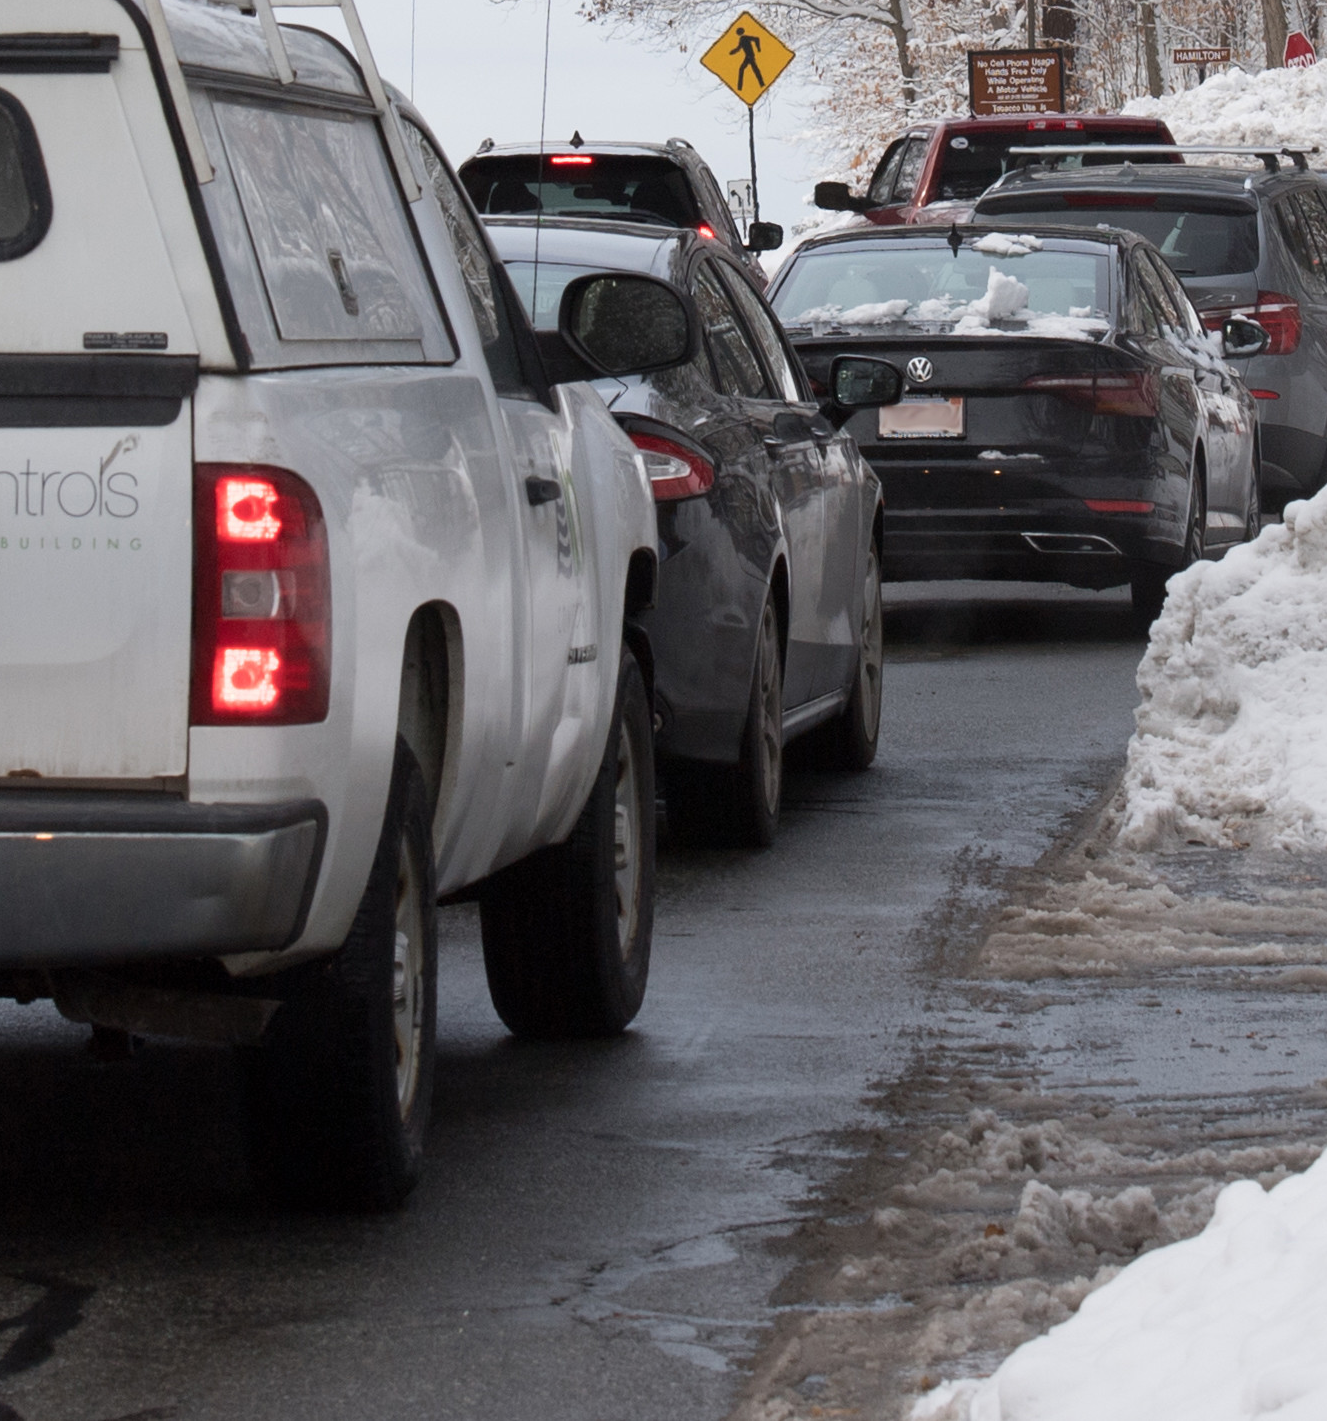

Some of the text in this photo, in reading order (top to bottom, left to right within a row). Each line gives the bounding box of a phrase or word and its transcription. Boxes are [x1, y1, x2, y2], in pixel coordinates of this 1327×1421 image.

[1176, 51, 1221, 61] HAMILTON
[990, 59, 1004, 67] Cell
[1006, 59, 1029, 67] Phone
[1032, 57, 1055, 67] Usage
[985, 66, 1047, 76] Hands Free Only
[987, 76, 1045, 85] While Operating
[987, 85, 1048, 94] A Motor Vehicle
[992, 104, 1021, 113] Tobacco
[1022, 103, 1036, 111] Use
[0, 537, 142, 550] BUILDING
